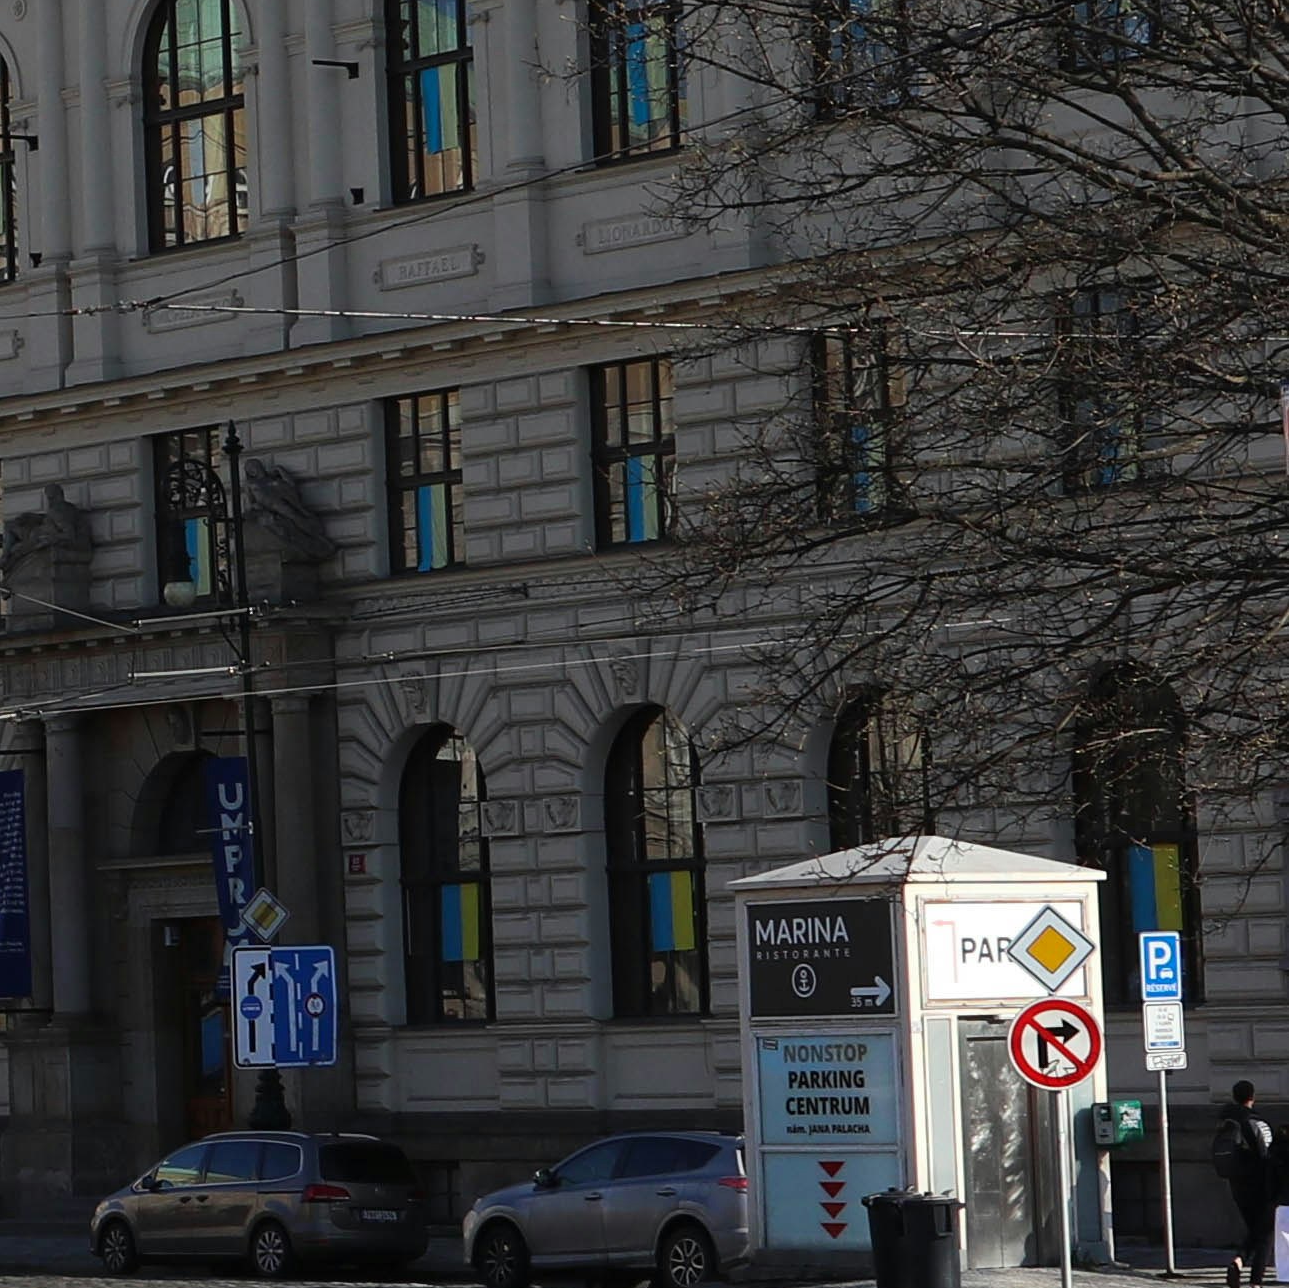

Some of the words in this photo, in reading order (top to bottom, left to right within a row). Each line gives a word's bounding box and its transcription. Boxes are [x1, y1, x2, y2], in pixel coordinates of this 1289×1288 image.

[398, 256, 461, 280] RAFFAEL
[755, 915, 849, 946] MARINA
[756, 947, 851, 960] RISTORANTE
[961, 936, 1015, 964] PAR
[1148, 940, 1172, 980] P
[850, 997, 862, 1008] 35
[783, 1043, 867, 1063] NONSTOP
[788, 1069, 865, 1089] PARKING
[785, 1096, 870, 1115] CENTRUM
[808, 1124, 831, 1135] JANA
[832, 1124, 871, 1134] PALACHA
